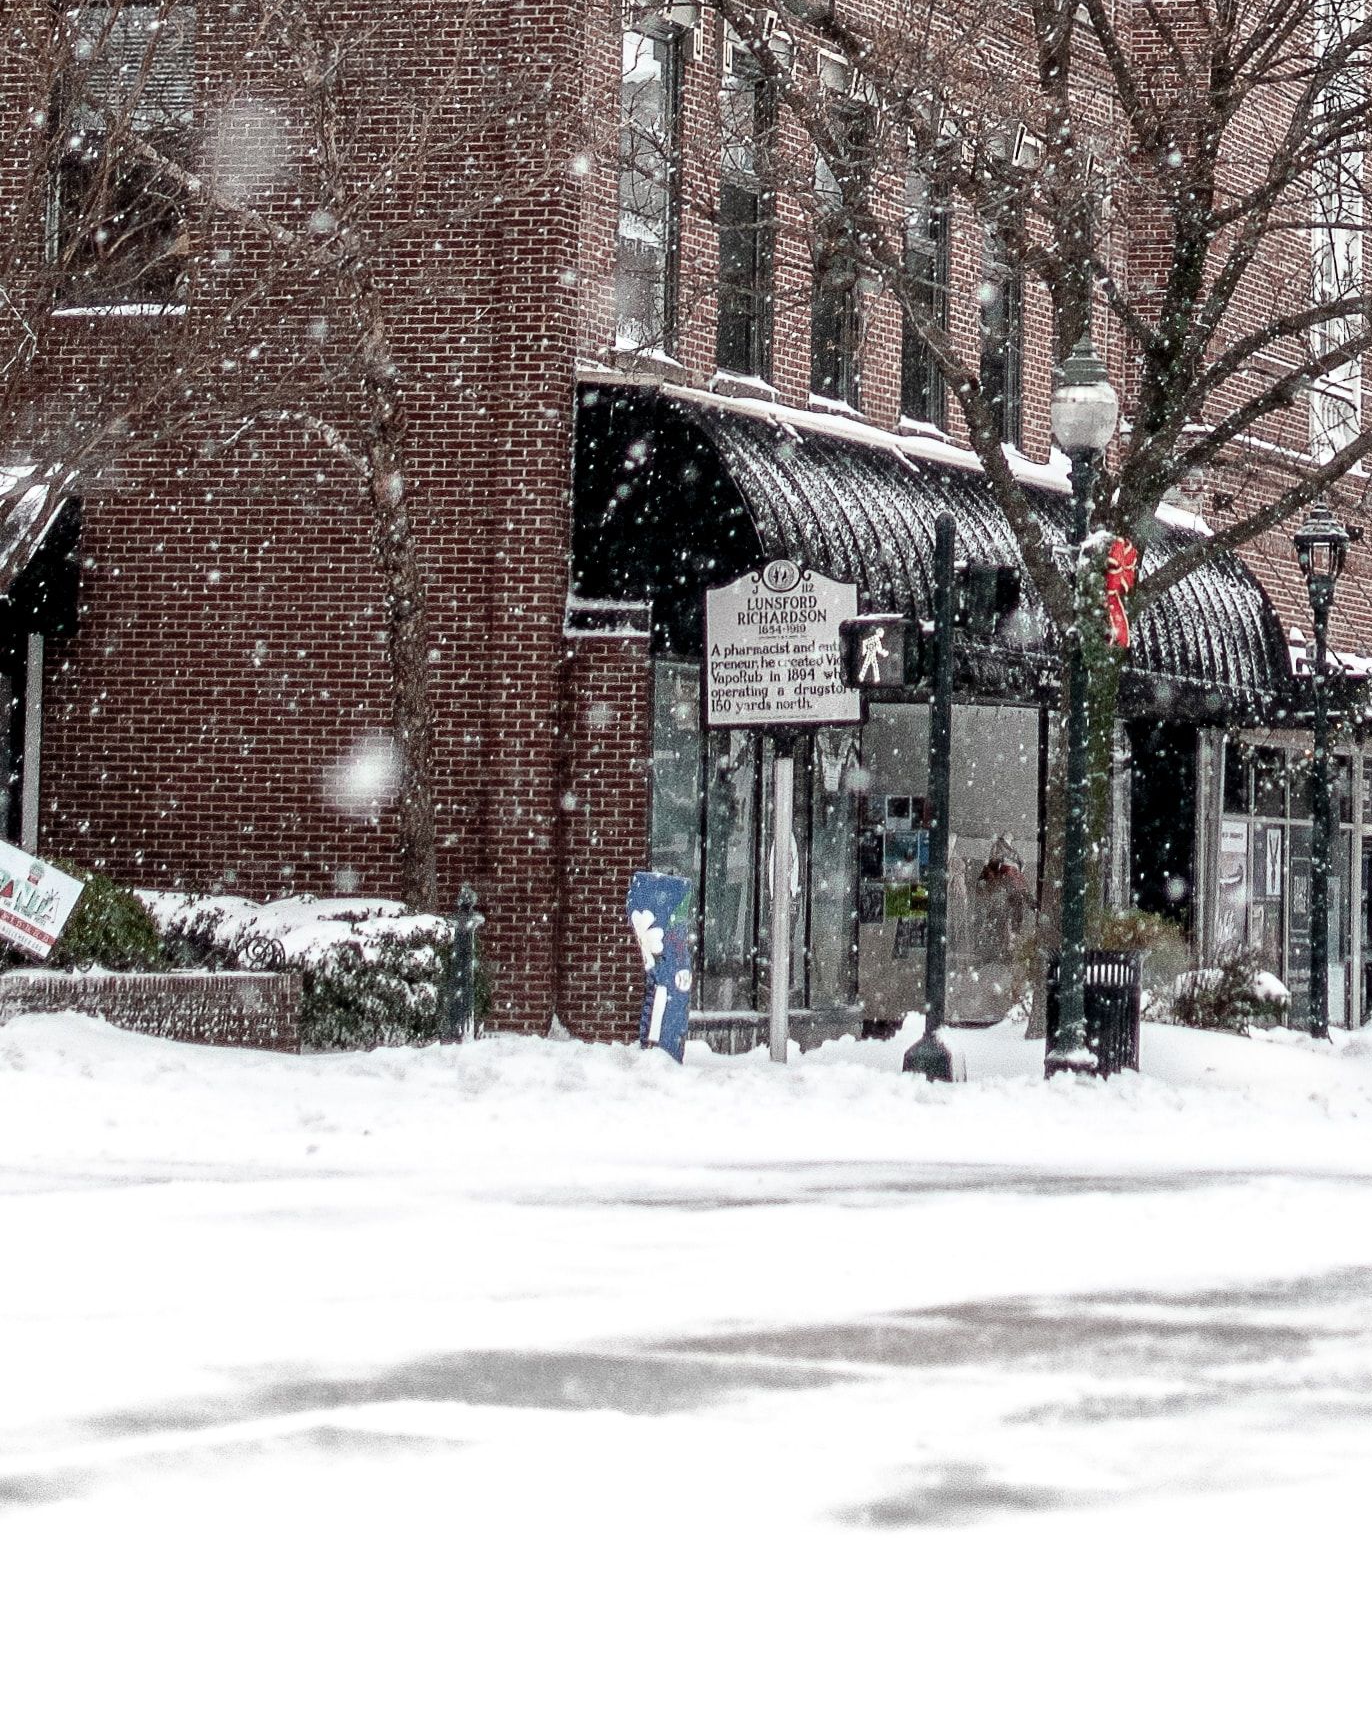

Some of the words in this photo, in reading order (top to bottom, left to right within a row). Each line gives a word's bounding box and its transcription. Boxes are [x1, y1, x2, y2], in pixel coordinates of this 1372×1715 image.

[747, 595, 817, 611] LUNSFORD
[737, 609, 827, 625] RICHARDSON
[711, 644, 720, 657] A
[724, 641, 790, 659] pharmacist
[793, 639, 815, 654] and
[761, 655, 776, 669] he
[711, 670, 763, 686] VapoRub
[769, 670, 781, 683] in
[787, 667, 815, 682] 1894
[711, 684, 769, 703] operating
[777, 686, 785, 697] a
[711, 698, 731, 713] 150
[776, 695, 813, 711] north.
